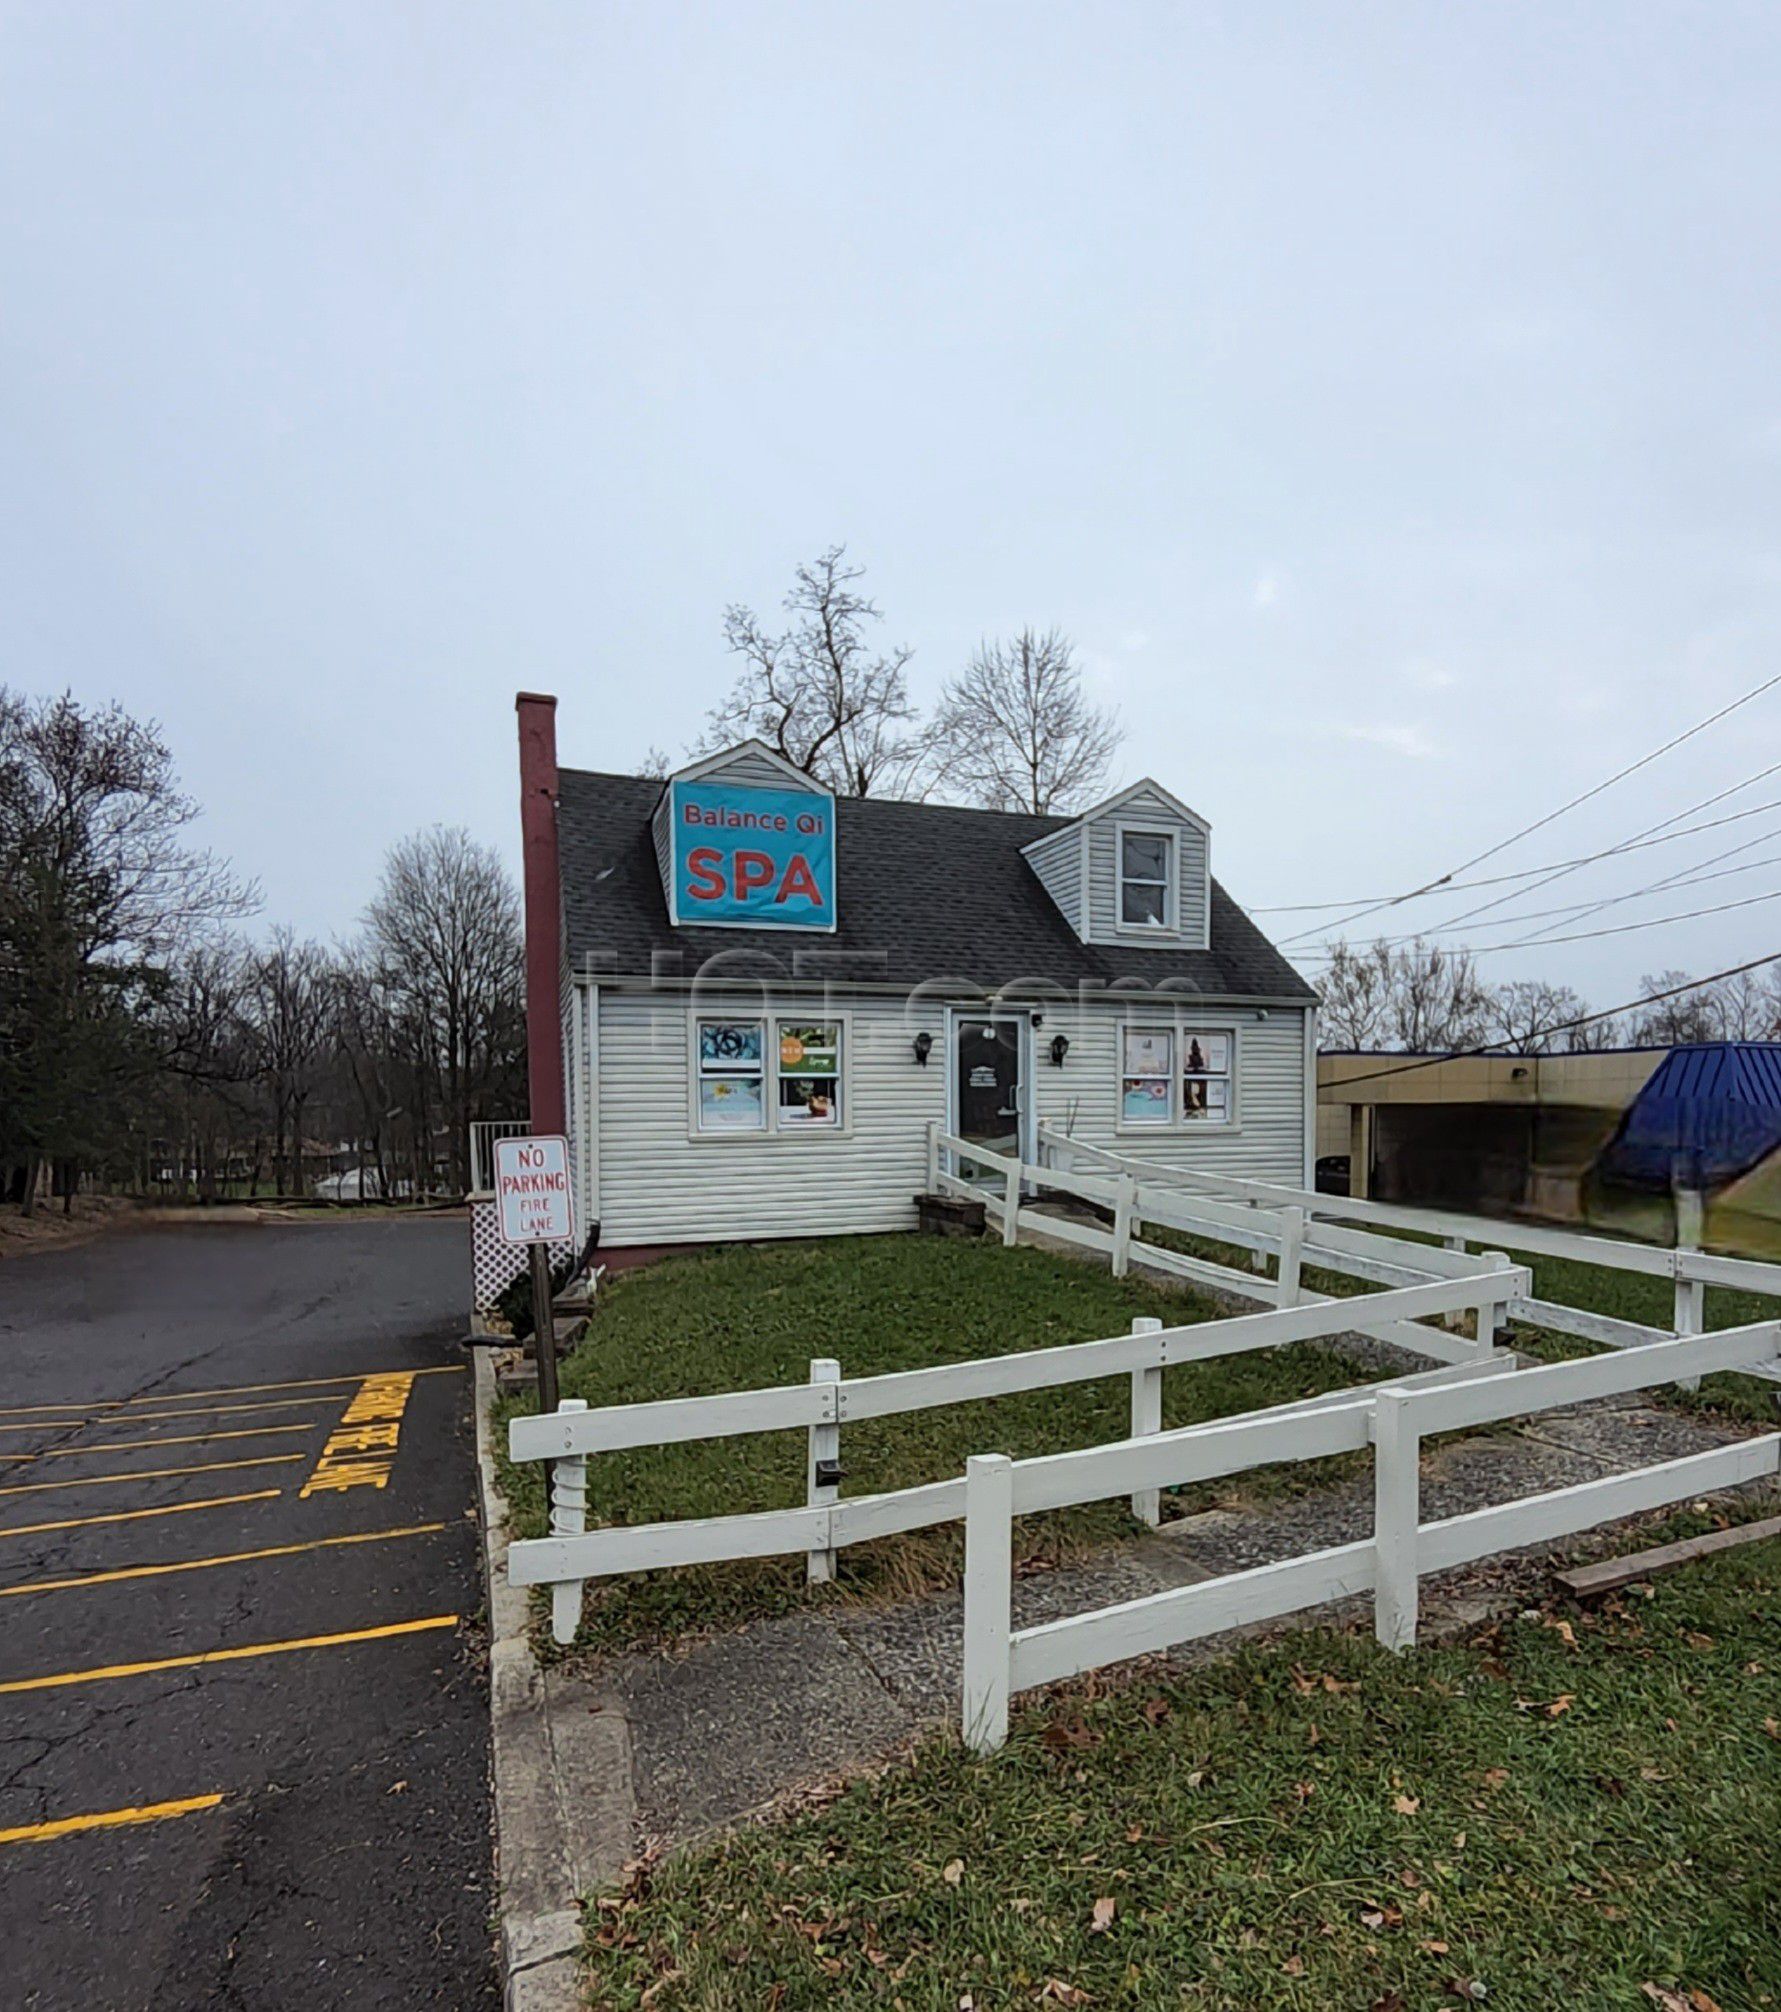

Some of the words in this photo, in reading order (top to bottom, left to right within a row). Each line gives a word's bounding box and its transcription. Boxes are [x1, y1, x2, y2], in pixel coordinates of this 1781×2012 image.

[684, 803, 788, 832] Balance
[796, 813, 824, 835] Qi
[687, 847, 824, 907] SPA
[518, 1148, 545, 1168] NO
[502, 1172, 566, 1196] PARKING
[519, 1197, 551, 1213] FIRE
[520, 1216, 554, 1233] LANE
